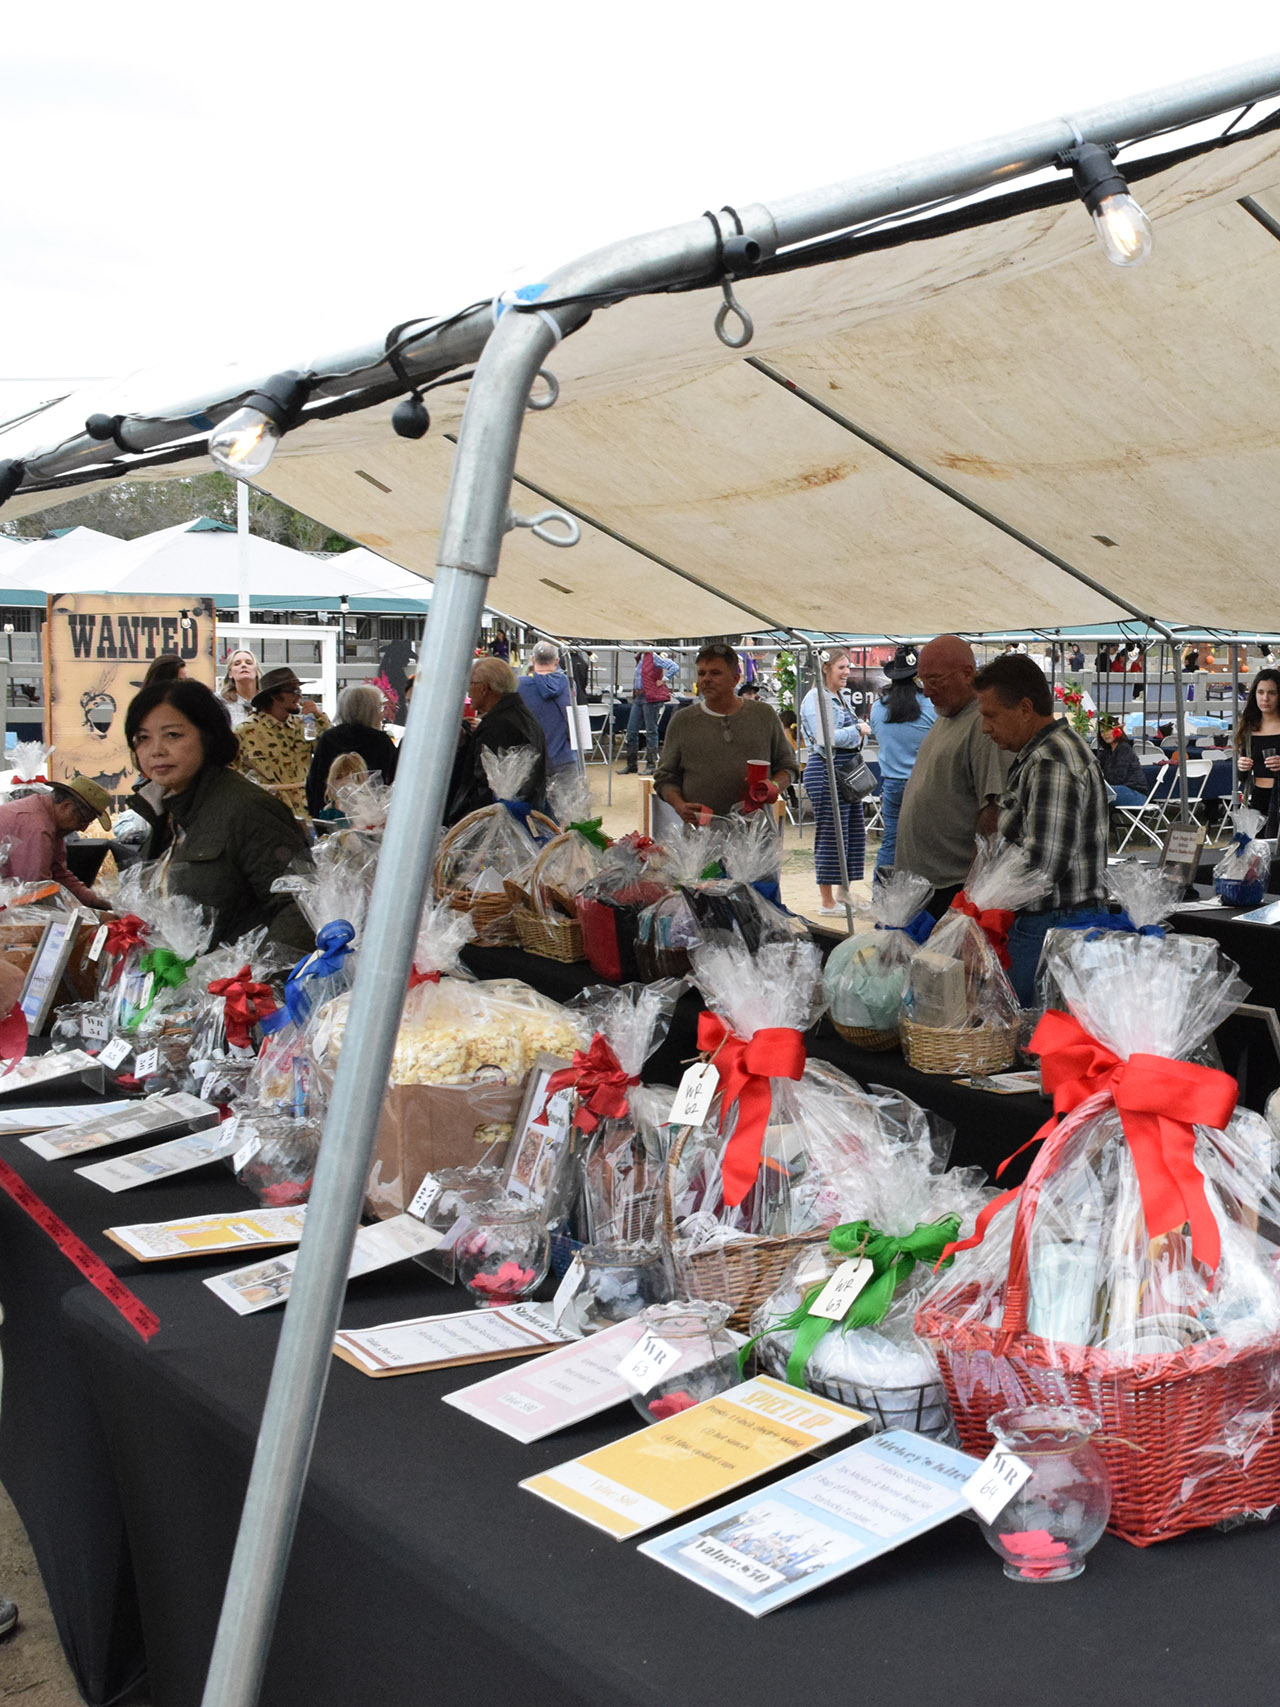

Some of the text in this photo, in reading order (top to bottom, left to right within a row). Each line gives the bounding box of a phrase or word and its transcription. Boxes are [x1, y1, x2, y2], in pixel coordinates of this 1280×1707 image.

[68, 614, 199, 659] WANTED
[841, 688, 880, 705] Gen
[685, 1083, 703, 1099] WR
[684, 1102, 700, 1115] 62
[834, 1278, 855, 1292] WR
[825, 1298, 843, 1312] 63
[643, 1339, 667, 1365] WR
[632, 1360, 649, 1377] 63
[741, 1390, 834, 1430] SPICE IT UP
[873, 1437, 933, 1467] Mickey's
[993, 1453, 1018, 1486] WR
[979, 1478, 998, 1500] 64
[695, 1540, 772, 1584] Value: $50
